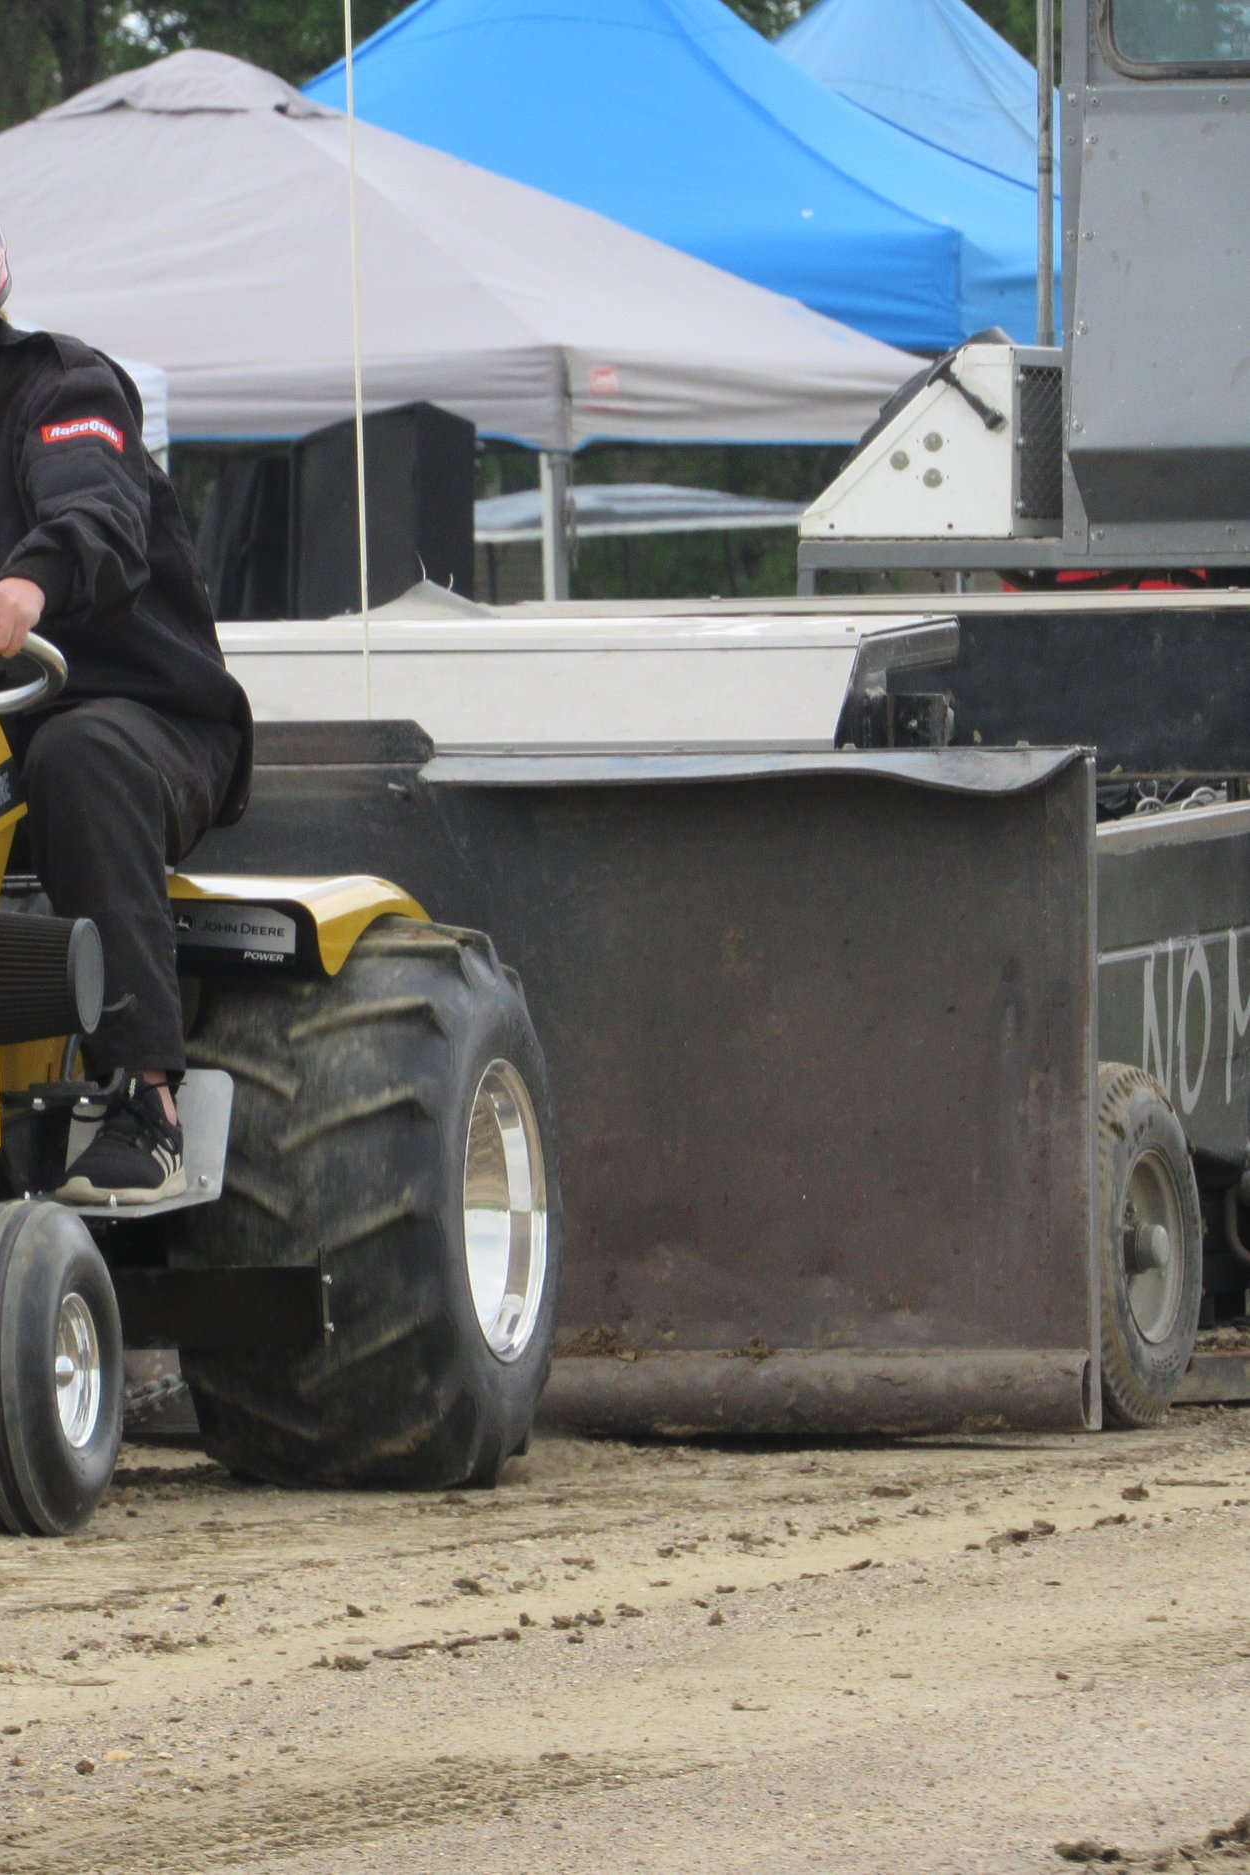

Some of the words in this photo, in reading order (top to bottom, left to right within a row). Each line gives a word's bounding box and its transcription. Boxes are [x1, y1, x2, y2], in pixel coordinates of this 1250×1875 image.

[201, 920, 238, 934] JOHN
[240, 922, 286, 938] DEERE
[243, 950, 285, 962] POWER
